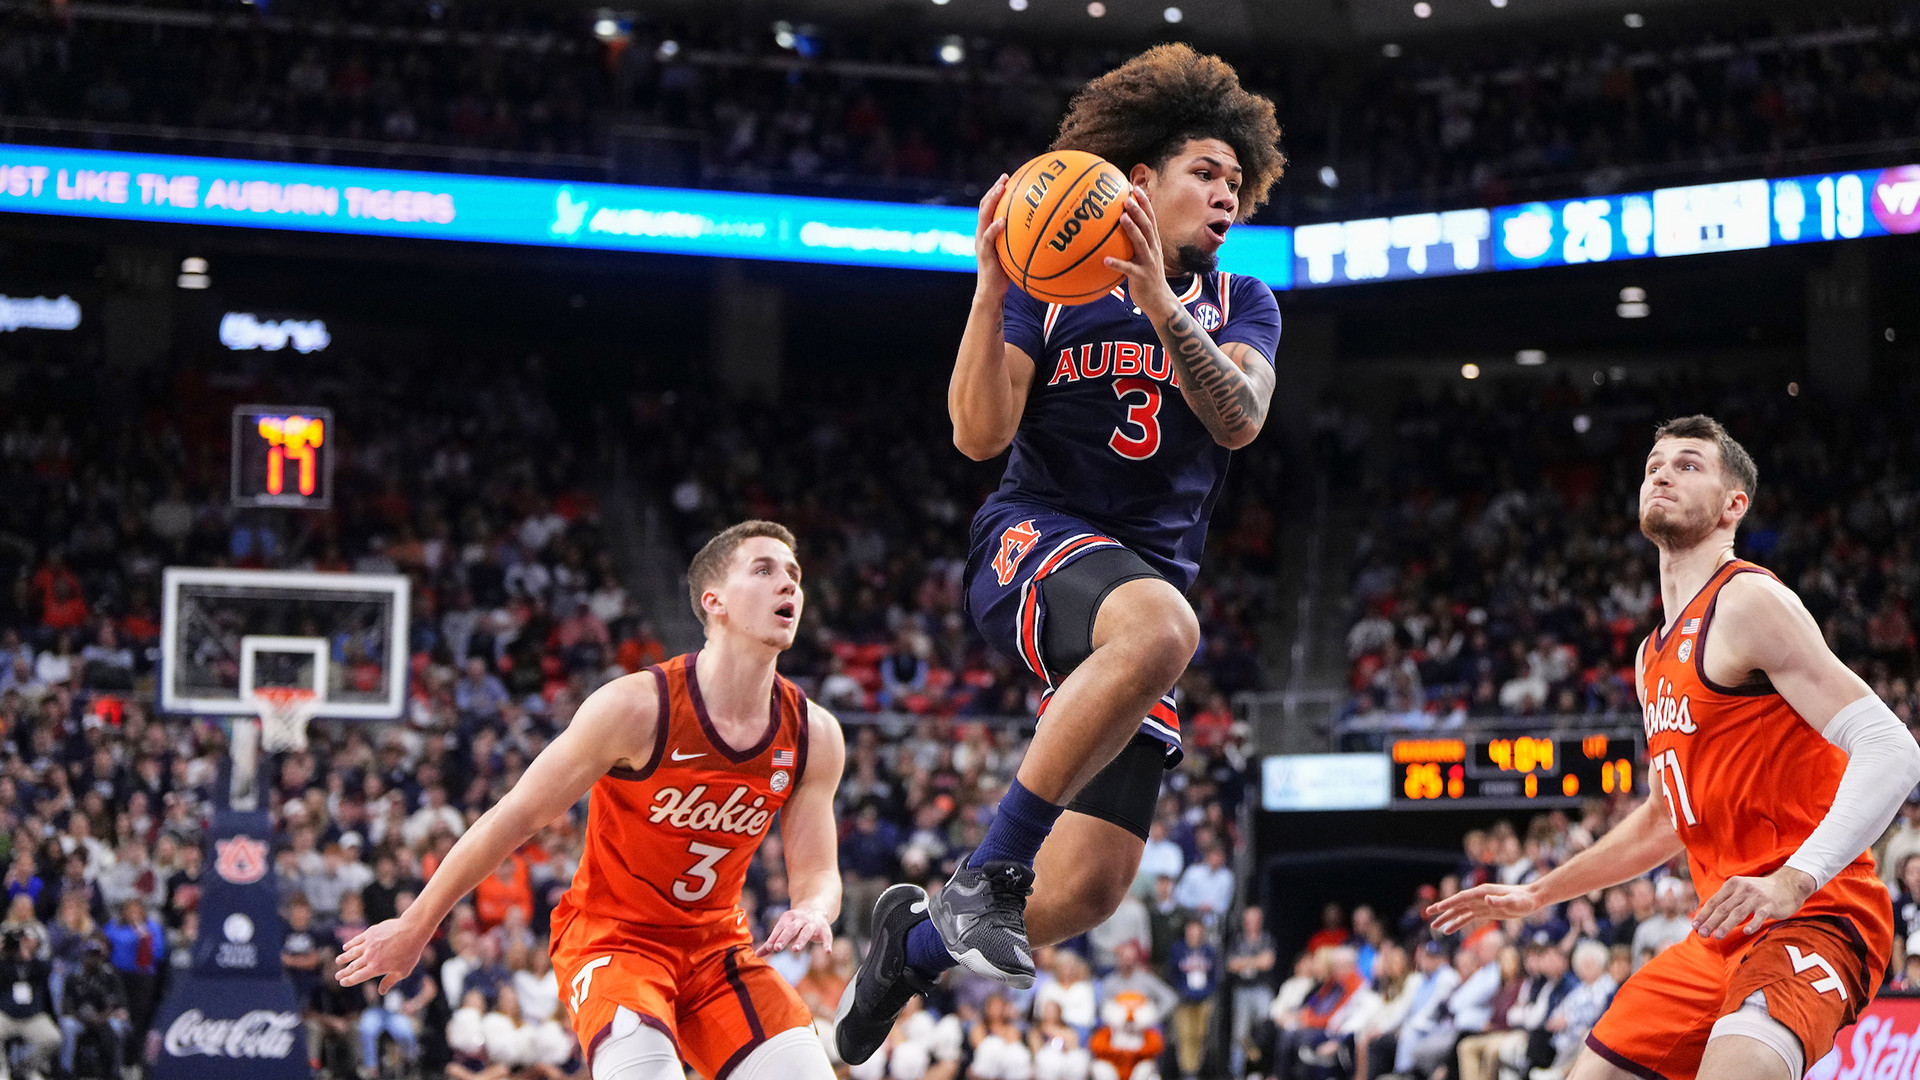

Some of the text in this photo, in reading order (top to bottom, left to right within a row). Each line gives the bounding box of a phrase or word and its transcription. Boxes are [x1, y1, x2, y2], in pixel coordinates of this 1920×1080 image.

[57, 168, 130, 204] LIKE
[137, 172, 199, 208] THE
[204, 178, 339, 217] AUBURN
[344, 187, 456, 225] TIGERS
[1025, 159, 1067, 209] EVO
[1048, 172, 1122, 252] Wilson
[1195, 303, 1222, 331] SEC
[1047, 341, 1181, 387] AUBU
[1108, 378, 1162, 460] 3
[267, 445, 316, 496] 17
[648, 784, 773, 836] Hokie
[671, 839, 736, 902] 3
[1785, 944, 1849, 1001] VT
